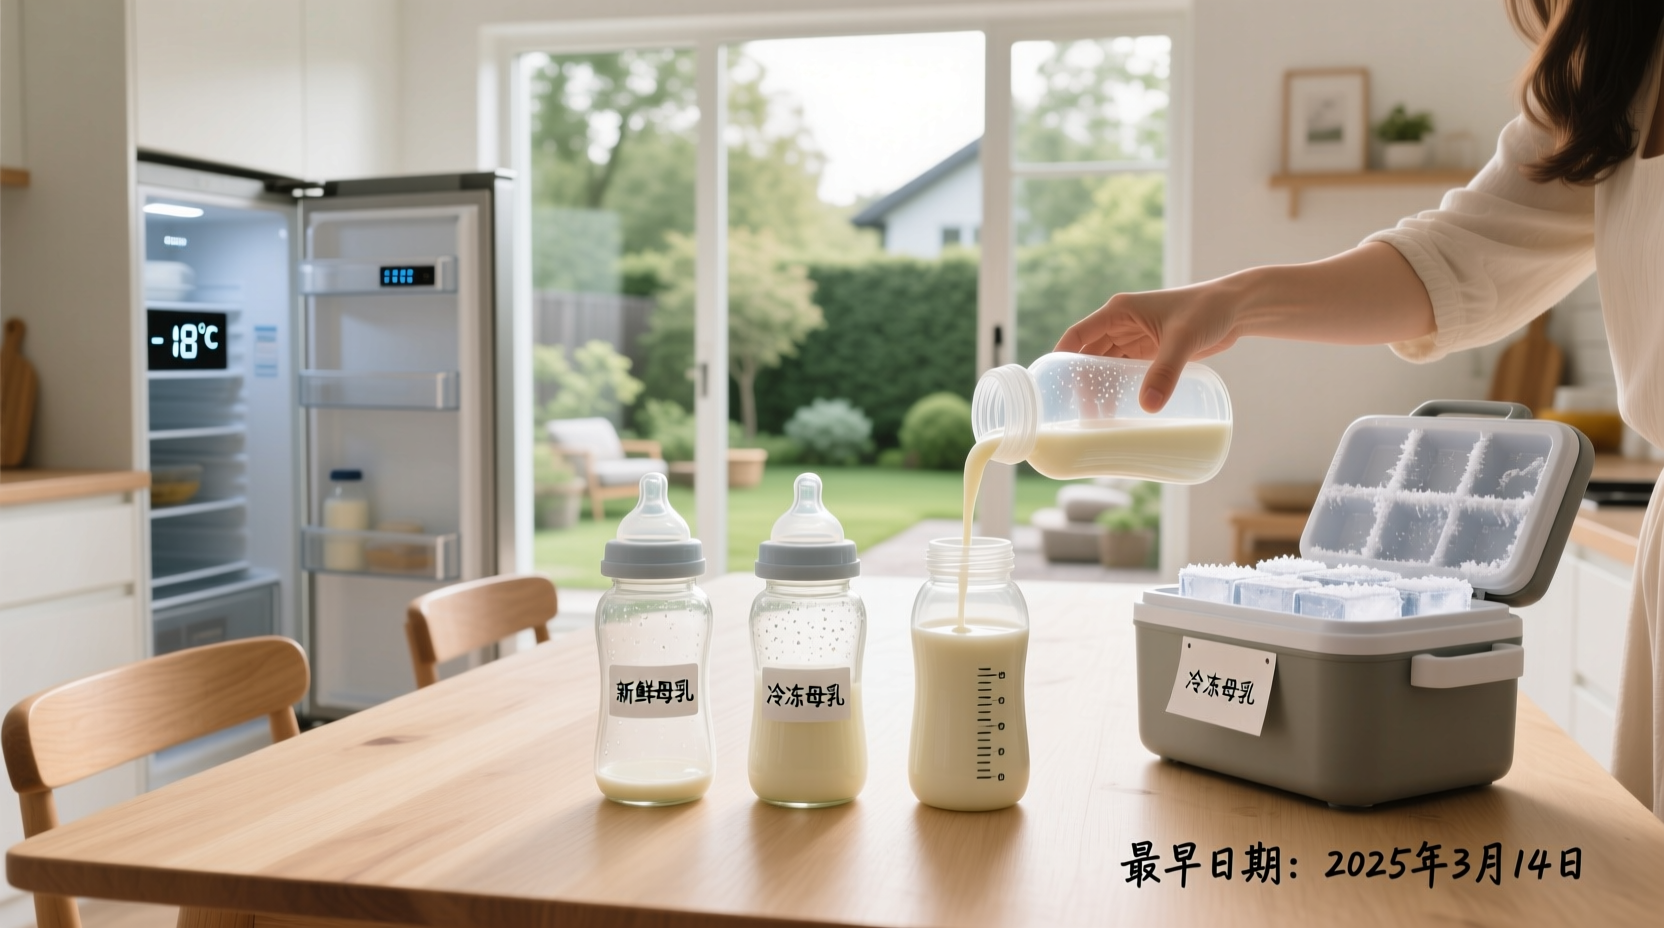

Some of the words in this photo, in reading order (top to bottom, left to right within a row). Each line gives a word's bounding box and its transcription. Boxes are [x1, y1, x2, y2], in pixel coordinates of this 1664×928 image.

[616, 679, 695, 705] 新鲜母乳
[766, 682, 845, 708] 冷冻母乳
[1186, 669, 1255, 706] 冷冻母乳
